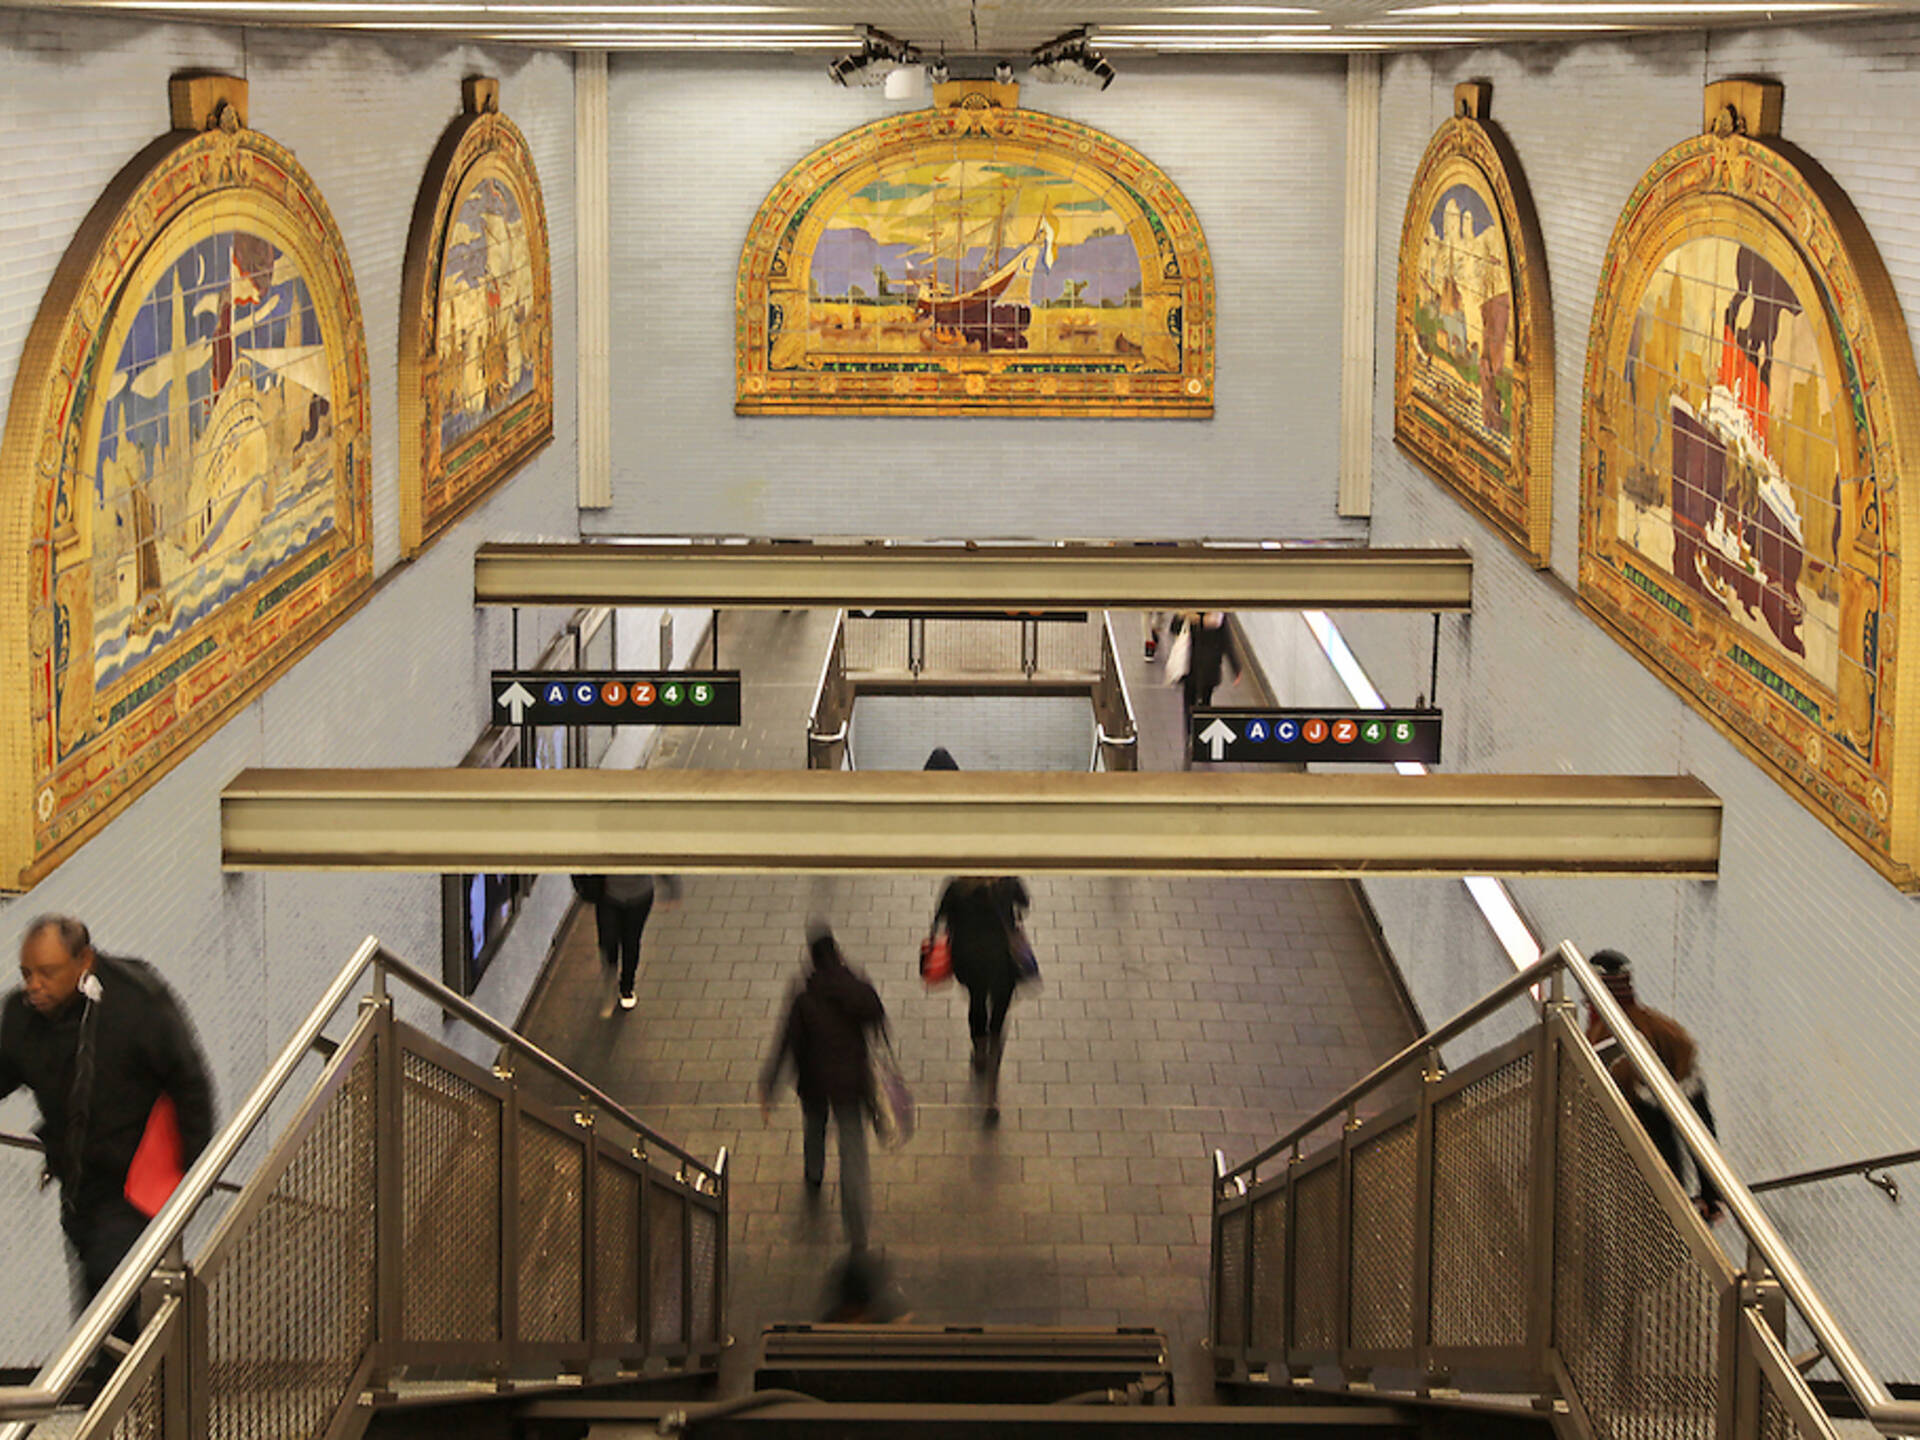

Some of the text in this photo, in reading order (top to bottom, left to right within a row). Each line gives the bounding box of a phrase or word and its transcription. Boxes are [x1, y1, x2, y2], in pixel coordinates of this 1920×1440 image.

[548, 685, 708, 702] A C J Z 4 5
[1250, 722, 1409, 740] A C J Z 4 5
